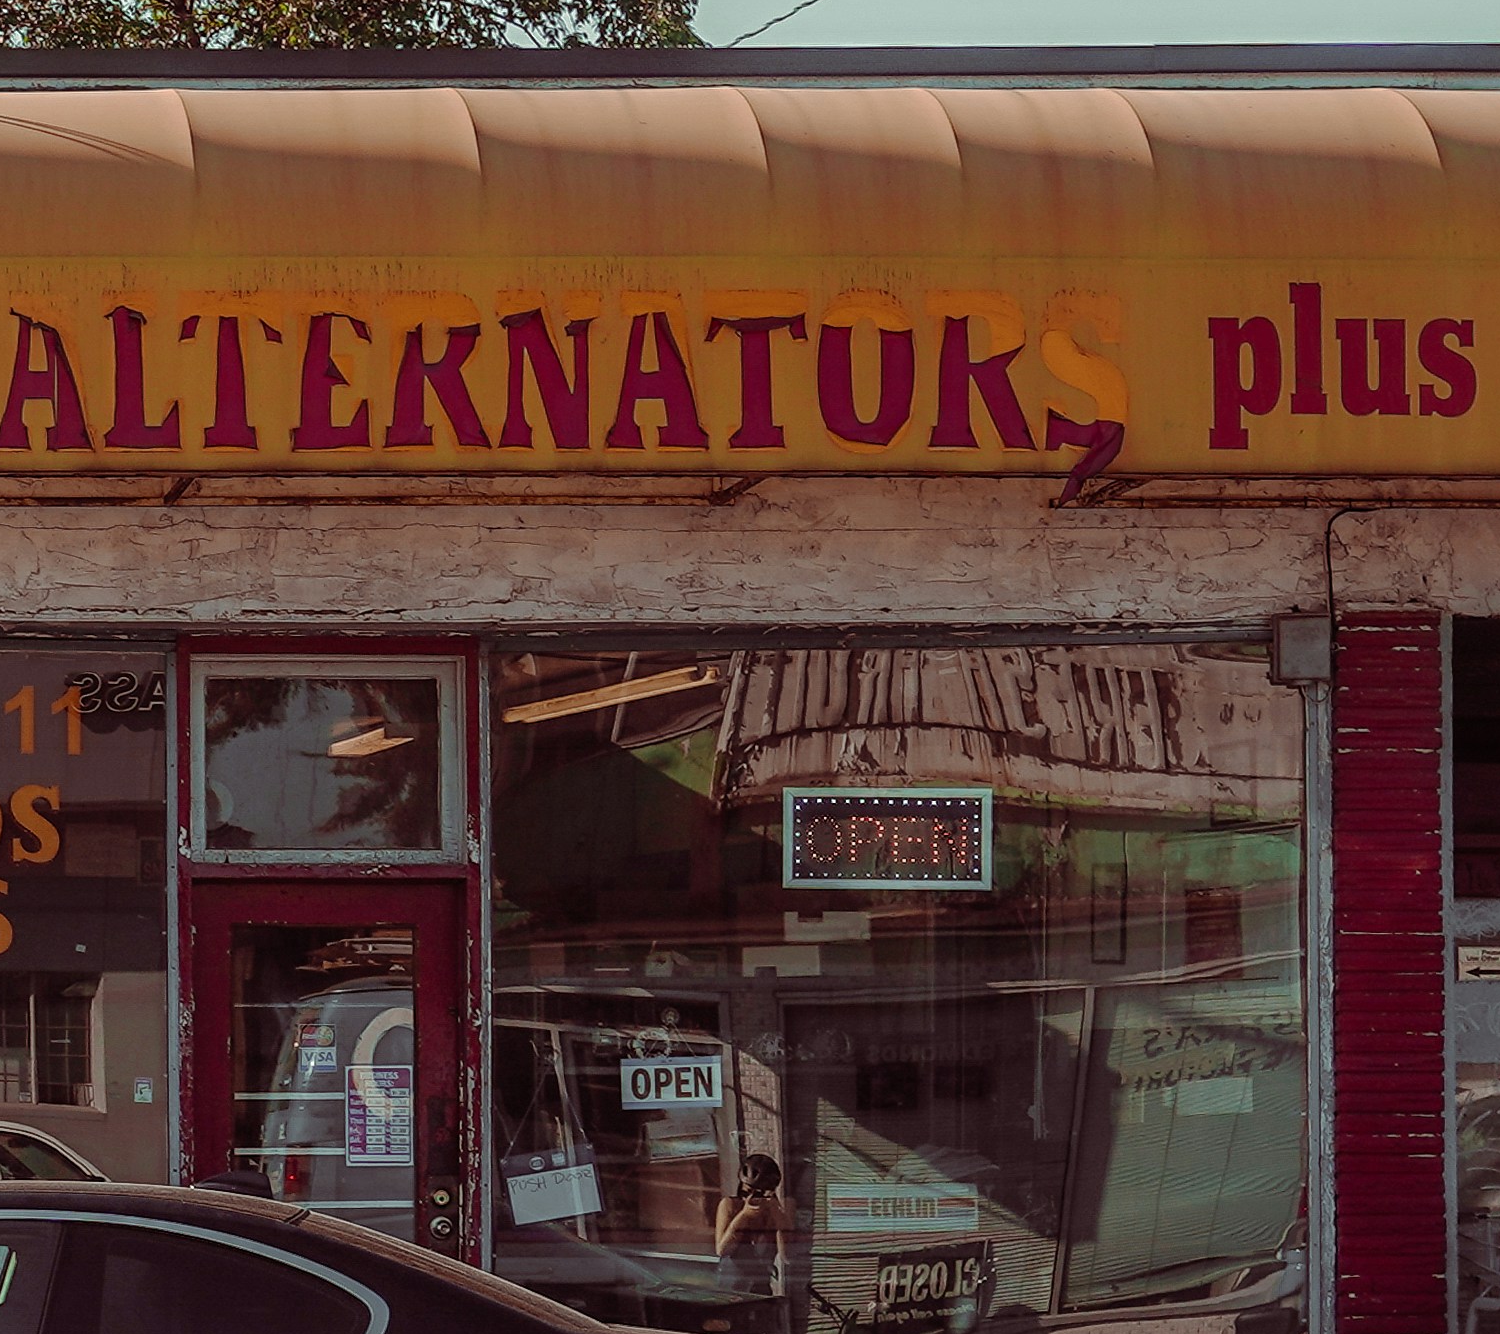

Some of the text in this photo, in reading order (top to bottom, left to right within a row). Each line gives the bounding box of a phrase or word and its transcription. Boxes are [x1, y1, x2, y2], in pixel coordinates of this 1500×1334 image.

[1207, 281, 1478, 451] plus
[806, 814, 969, 866] OPEN
[630, 1066, 714, 1100] OPEN
[508, 1176, 548, 1196] PUSH
